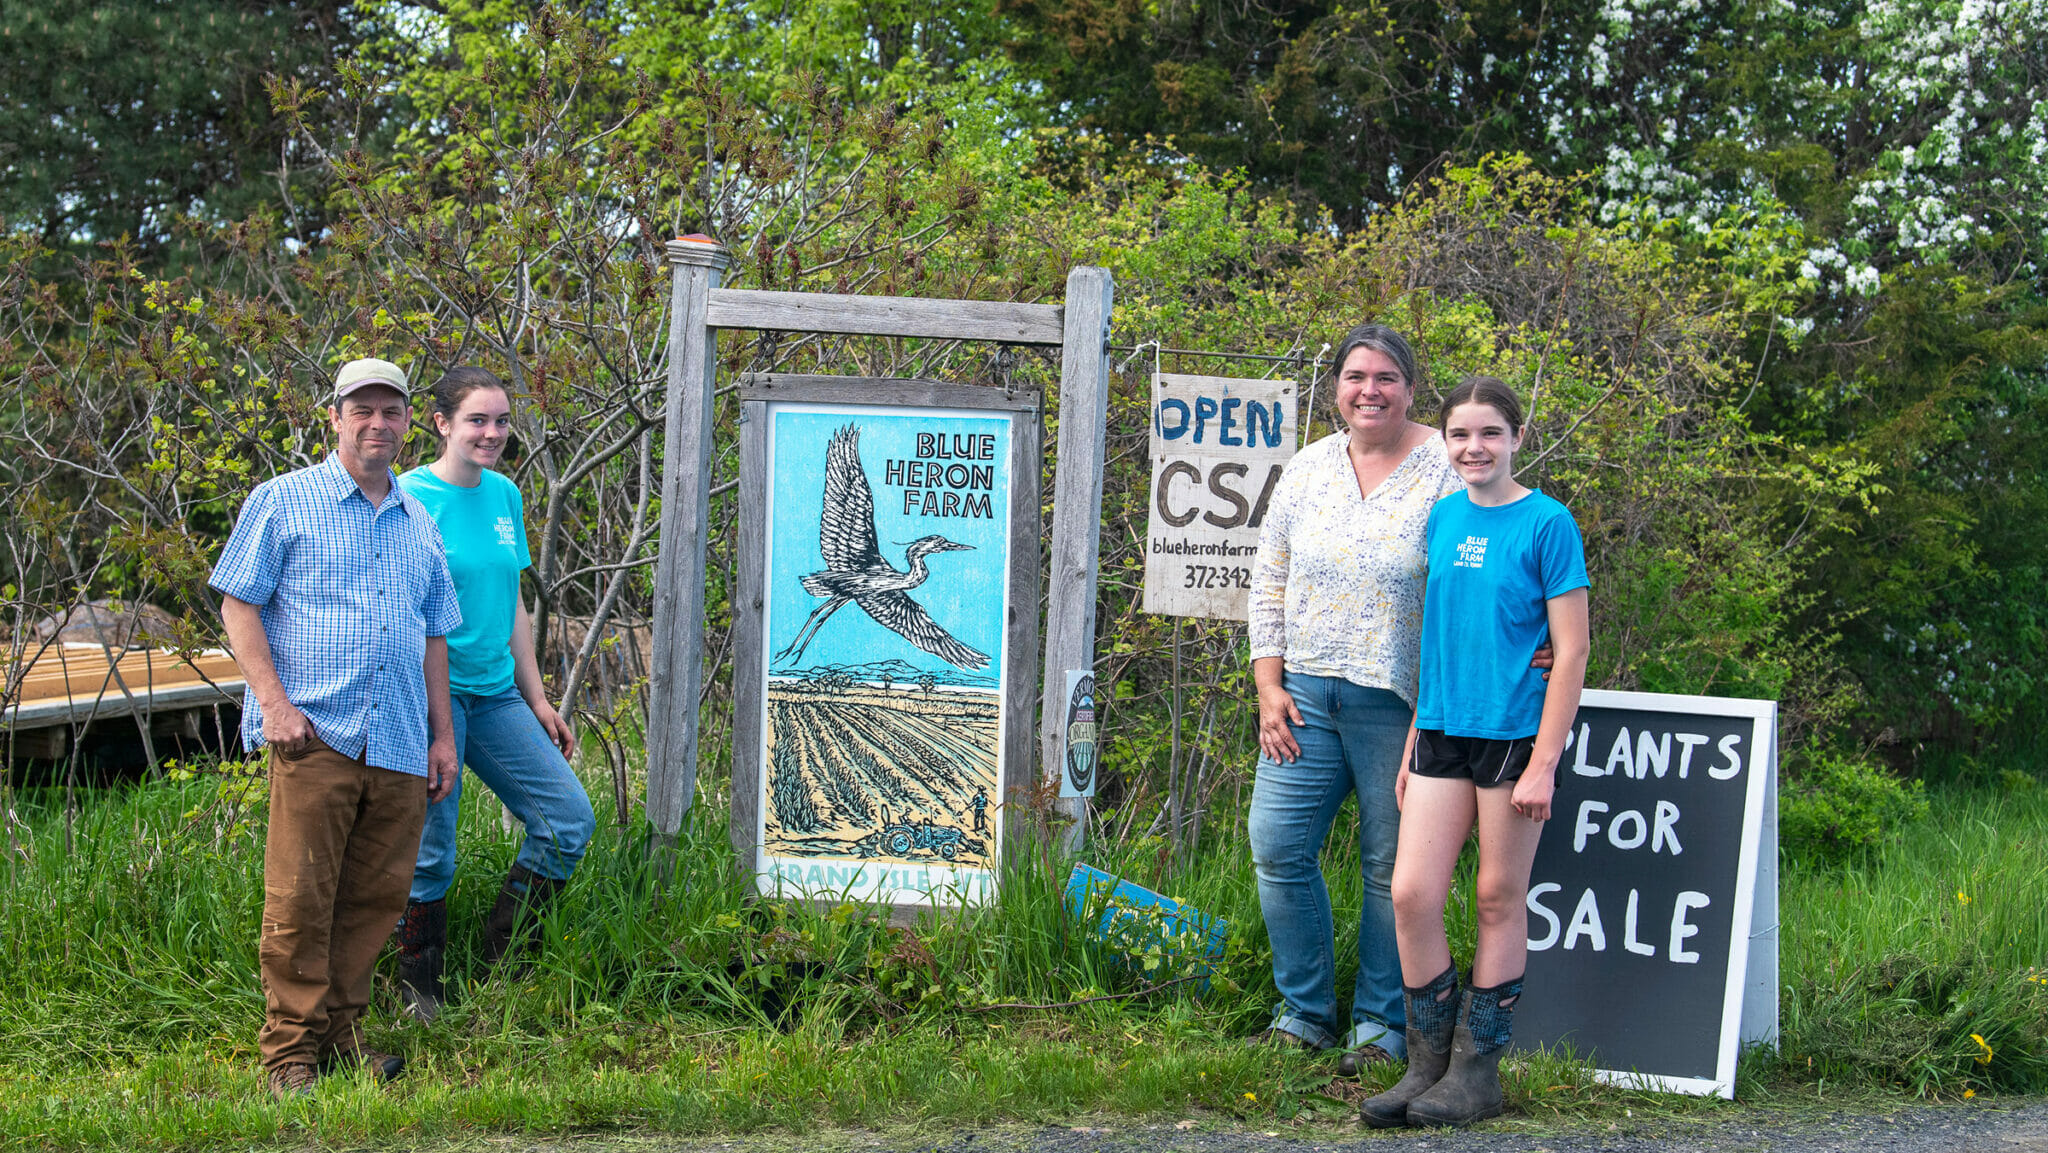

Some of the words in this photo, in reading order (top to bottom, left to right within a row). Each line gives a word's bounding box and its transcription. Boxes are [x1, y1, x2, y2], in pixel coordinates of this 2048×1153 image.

[1155, 395, 1283, 448] OPEN
[916, 432, 995, 460] BLUE
[885, 459, 994, 490] HERON
[903, 490, 994, 519] FARM
[1456, 543, 1487, 554] HERON
[1466, 535, 1488, 546] BLUE
[1184, 565, 1252, 589] 372-342
[1565, 722, 1742, 780] LANTS
[1573, 800, 1683, 856] FOR
[767, 863, 869, 888] GRAND
[1527, 882, 1711, 964] SALE
